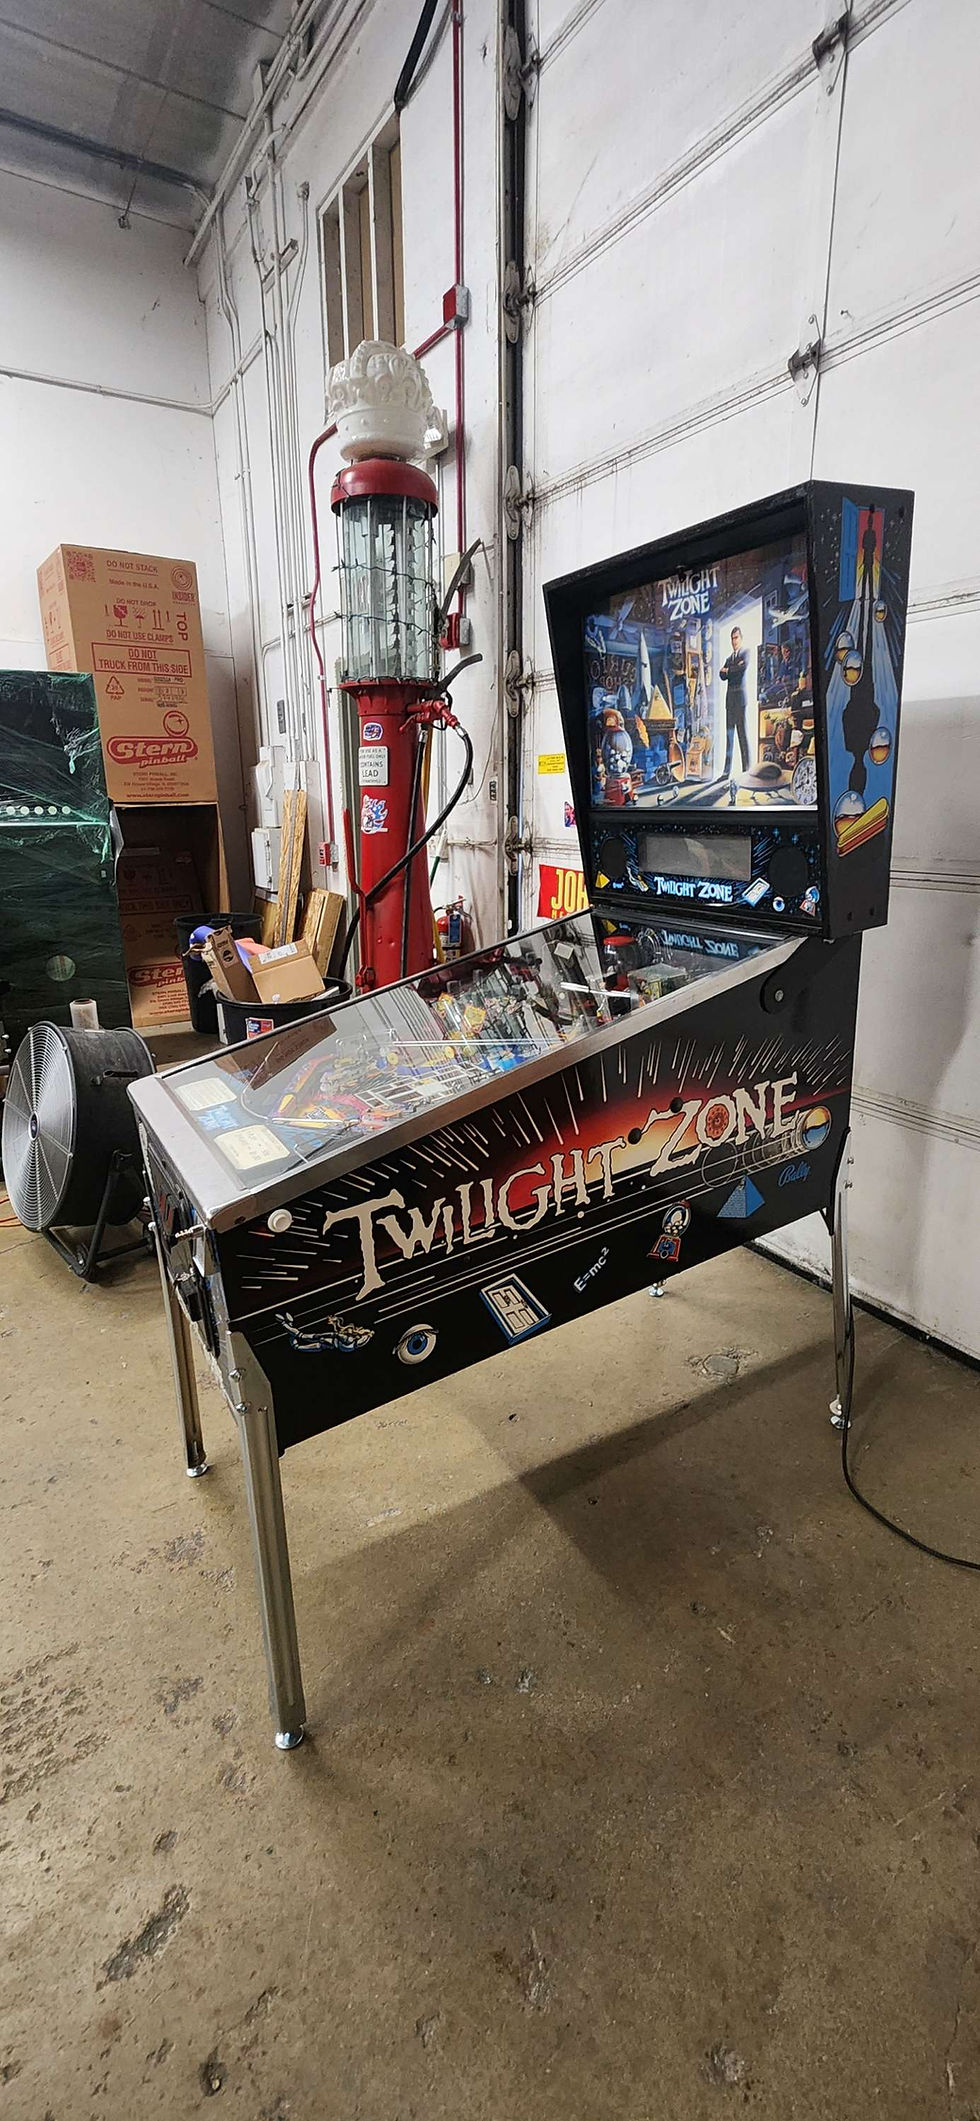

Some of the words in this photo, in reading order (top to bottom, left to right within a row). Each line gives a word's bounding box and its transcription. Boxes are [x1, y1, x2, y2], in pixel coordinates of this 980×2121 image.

[106, 560, 118, 568] DO
[120, 562, 134, 570] NOT
[136, 563, 158, 573] STACK
[658, 566, 721, 607] TWILIGHT
[668, 591, 712, 621] ZONE
[176, 611, 188, 641] TOP
[106, 629, 117, 638] DO
[118, 631, 131, 639] NOT
[133, 632, 146, 640] USE
[147, 633, 174, 643] CLAMPS
[128, 648, 140, 658] DO
[141, 650, 157, 659] NOT
[98, 659, 126, 670] TRUCK
[127, 661, 151, 671] FROM
[152, 662, 169, 673] THIS
[170, 664, 188, 674] SIDE
[116, 742, 189, 759] Stern
[139, 754, 187, 768] pinball
[362, 769, 379, 778] LEAD
[653, 876, 697, 898] TWILIGHT
[697, 880, 734, 902] ZONE
[135, 967, 184, 982] Ster
[778, 1160, 812, 1188] Bally
[322, 1136, 627, 1301] TWILIGHT
[639, 1071, 801, 1177] ZONE
